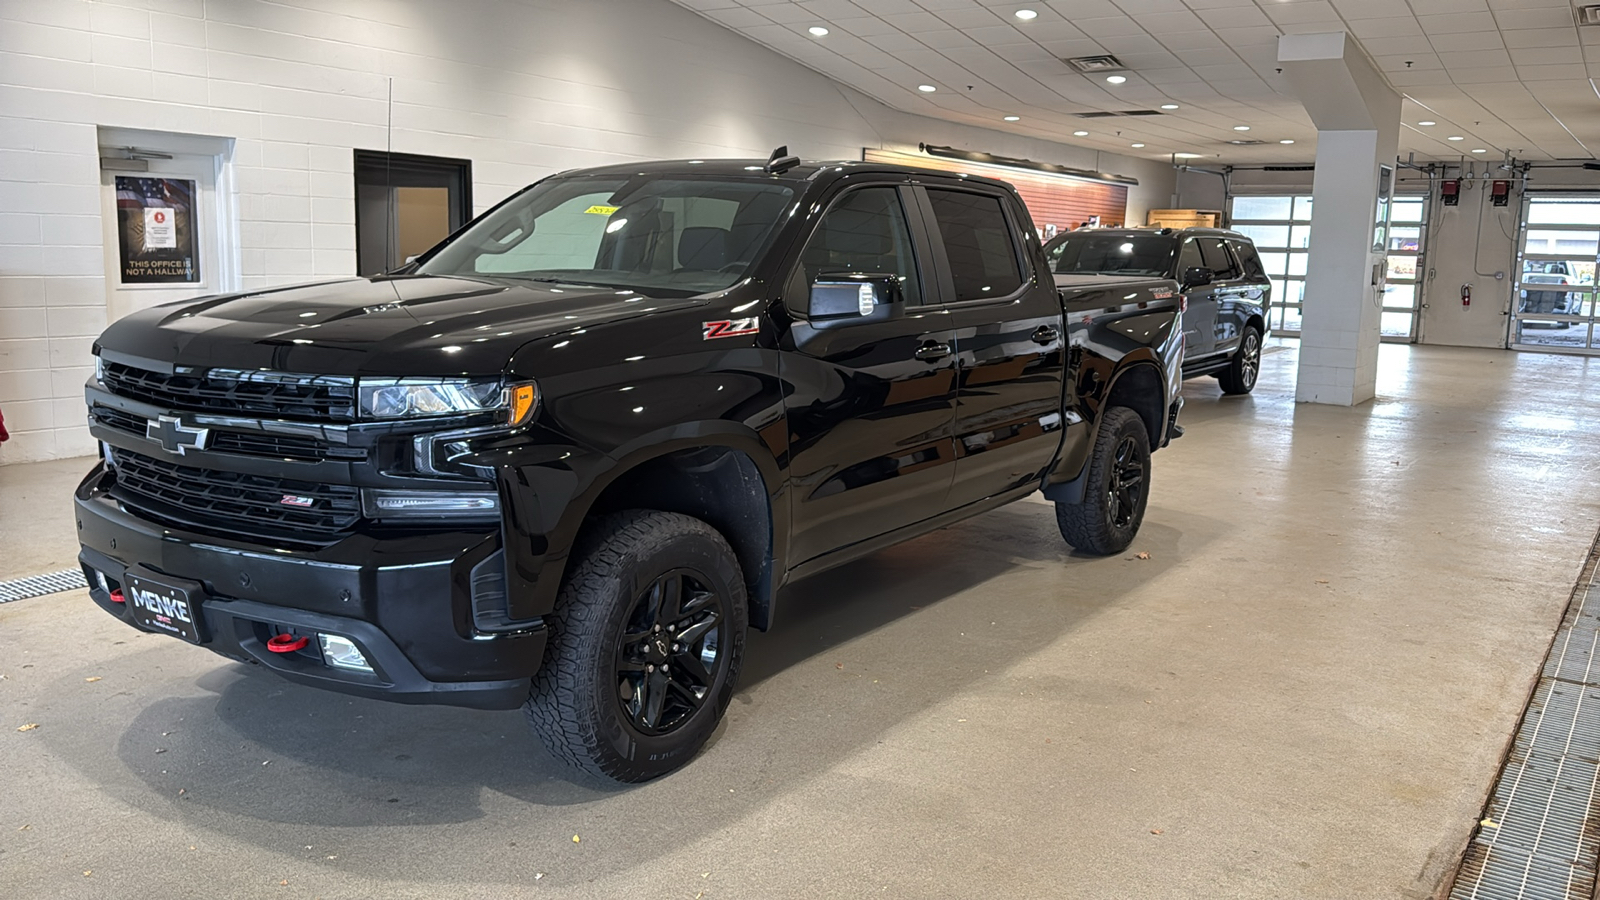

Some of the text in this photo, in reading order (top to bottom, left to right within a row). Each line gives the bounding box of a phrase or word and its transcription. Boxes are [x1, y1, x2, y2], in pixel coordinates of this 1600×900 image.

[702, 316, 759, 340] Z71
[281, 495, 314, 507] Z71
[131, 587, 191, 622] MENKE
